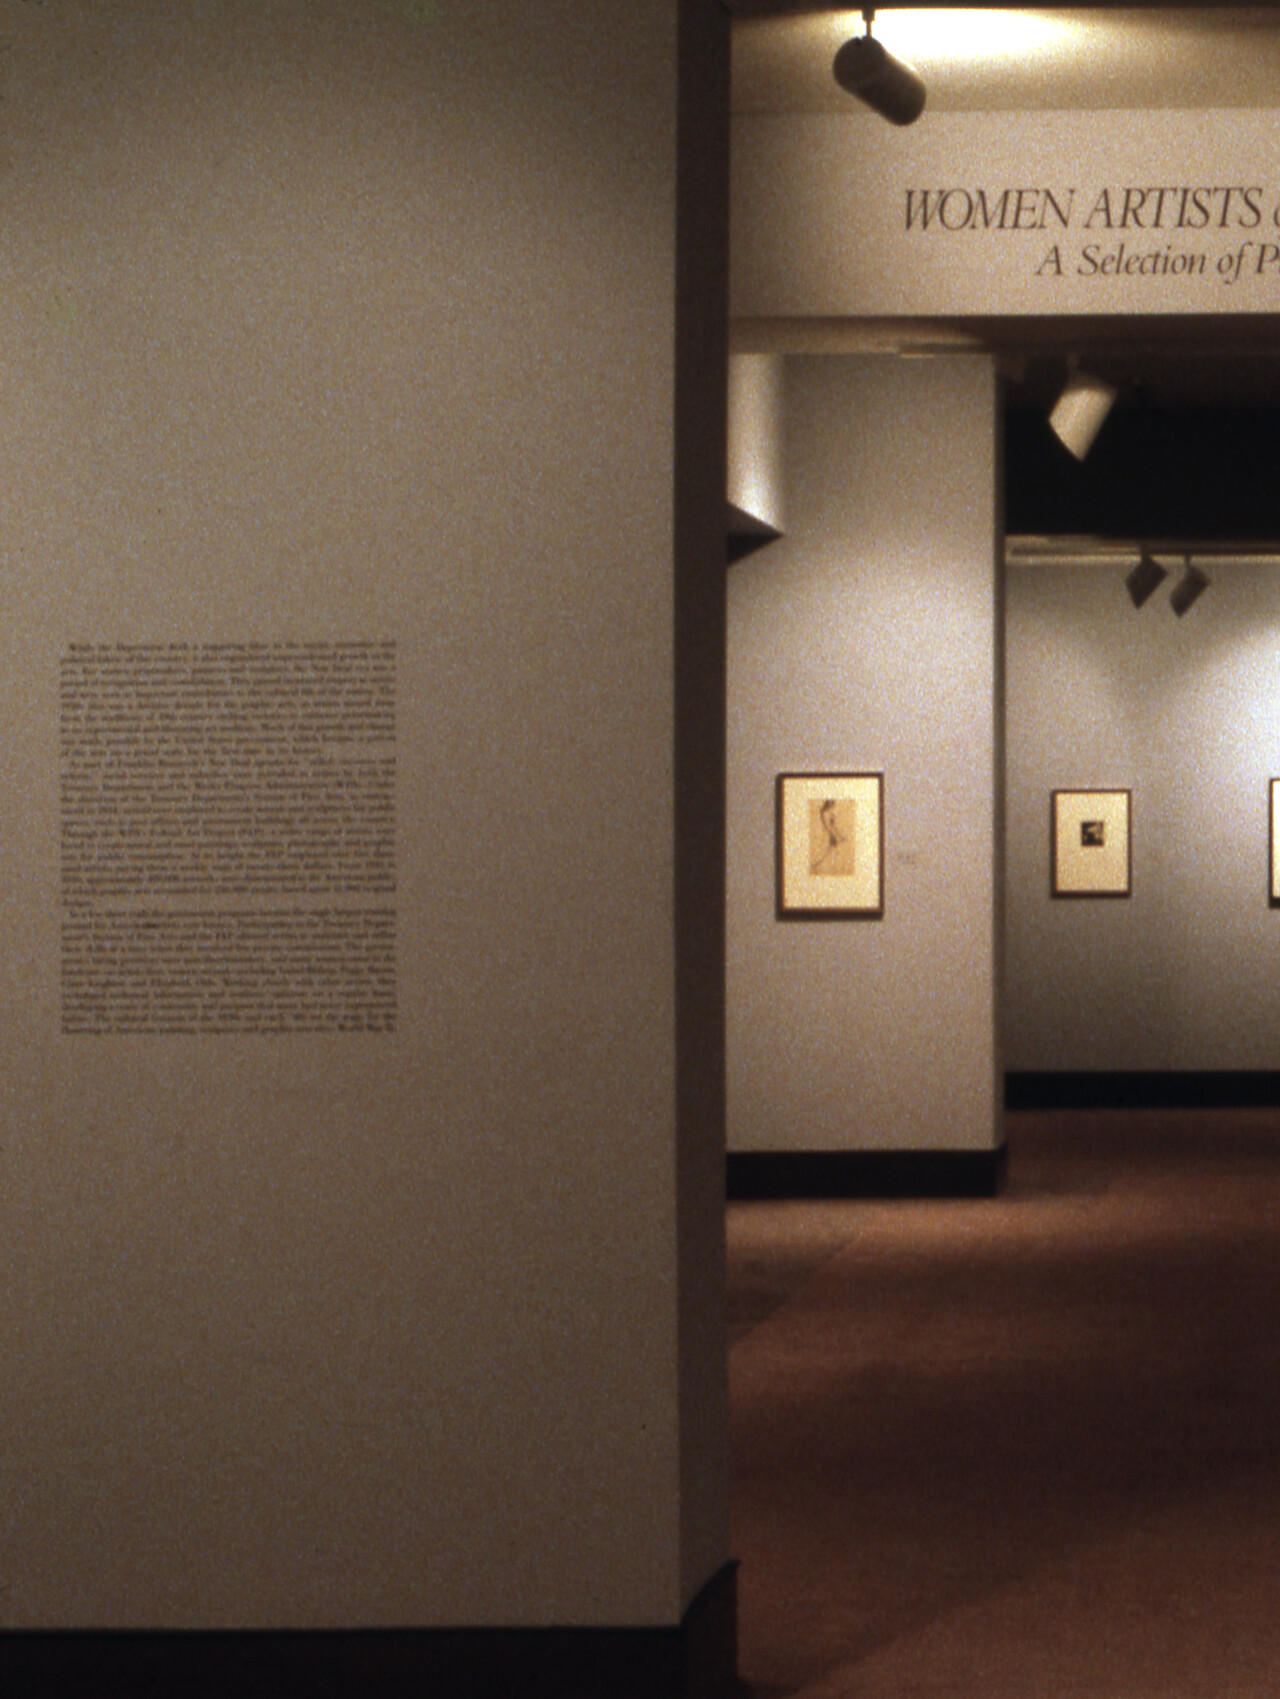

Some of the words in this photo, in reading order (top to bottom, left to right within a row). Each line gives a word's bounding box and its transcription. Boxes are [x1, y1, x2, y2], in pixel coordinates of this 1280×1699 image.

[904, 188, 1077, 231] WOMEN
[1083, 187, 1264, 229] ARTISTS
[1034, 244, 1064, 276] A
[1076, 243, 1207, 276] Selection
[1216, 242, 1253, 285] of
